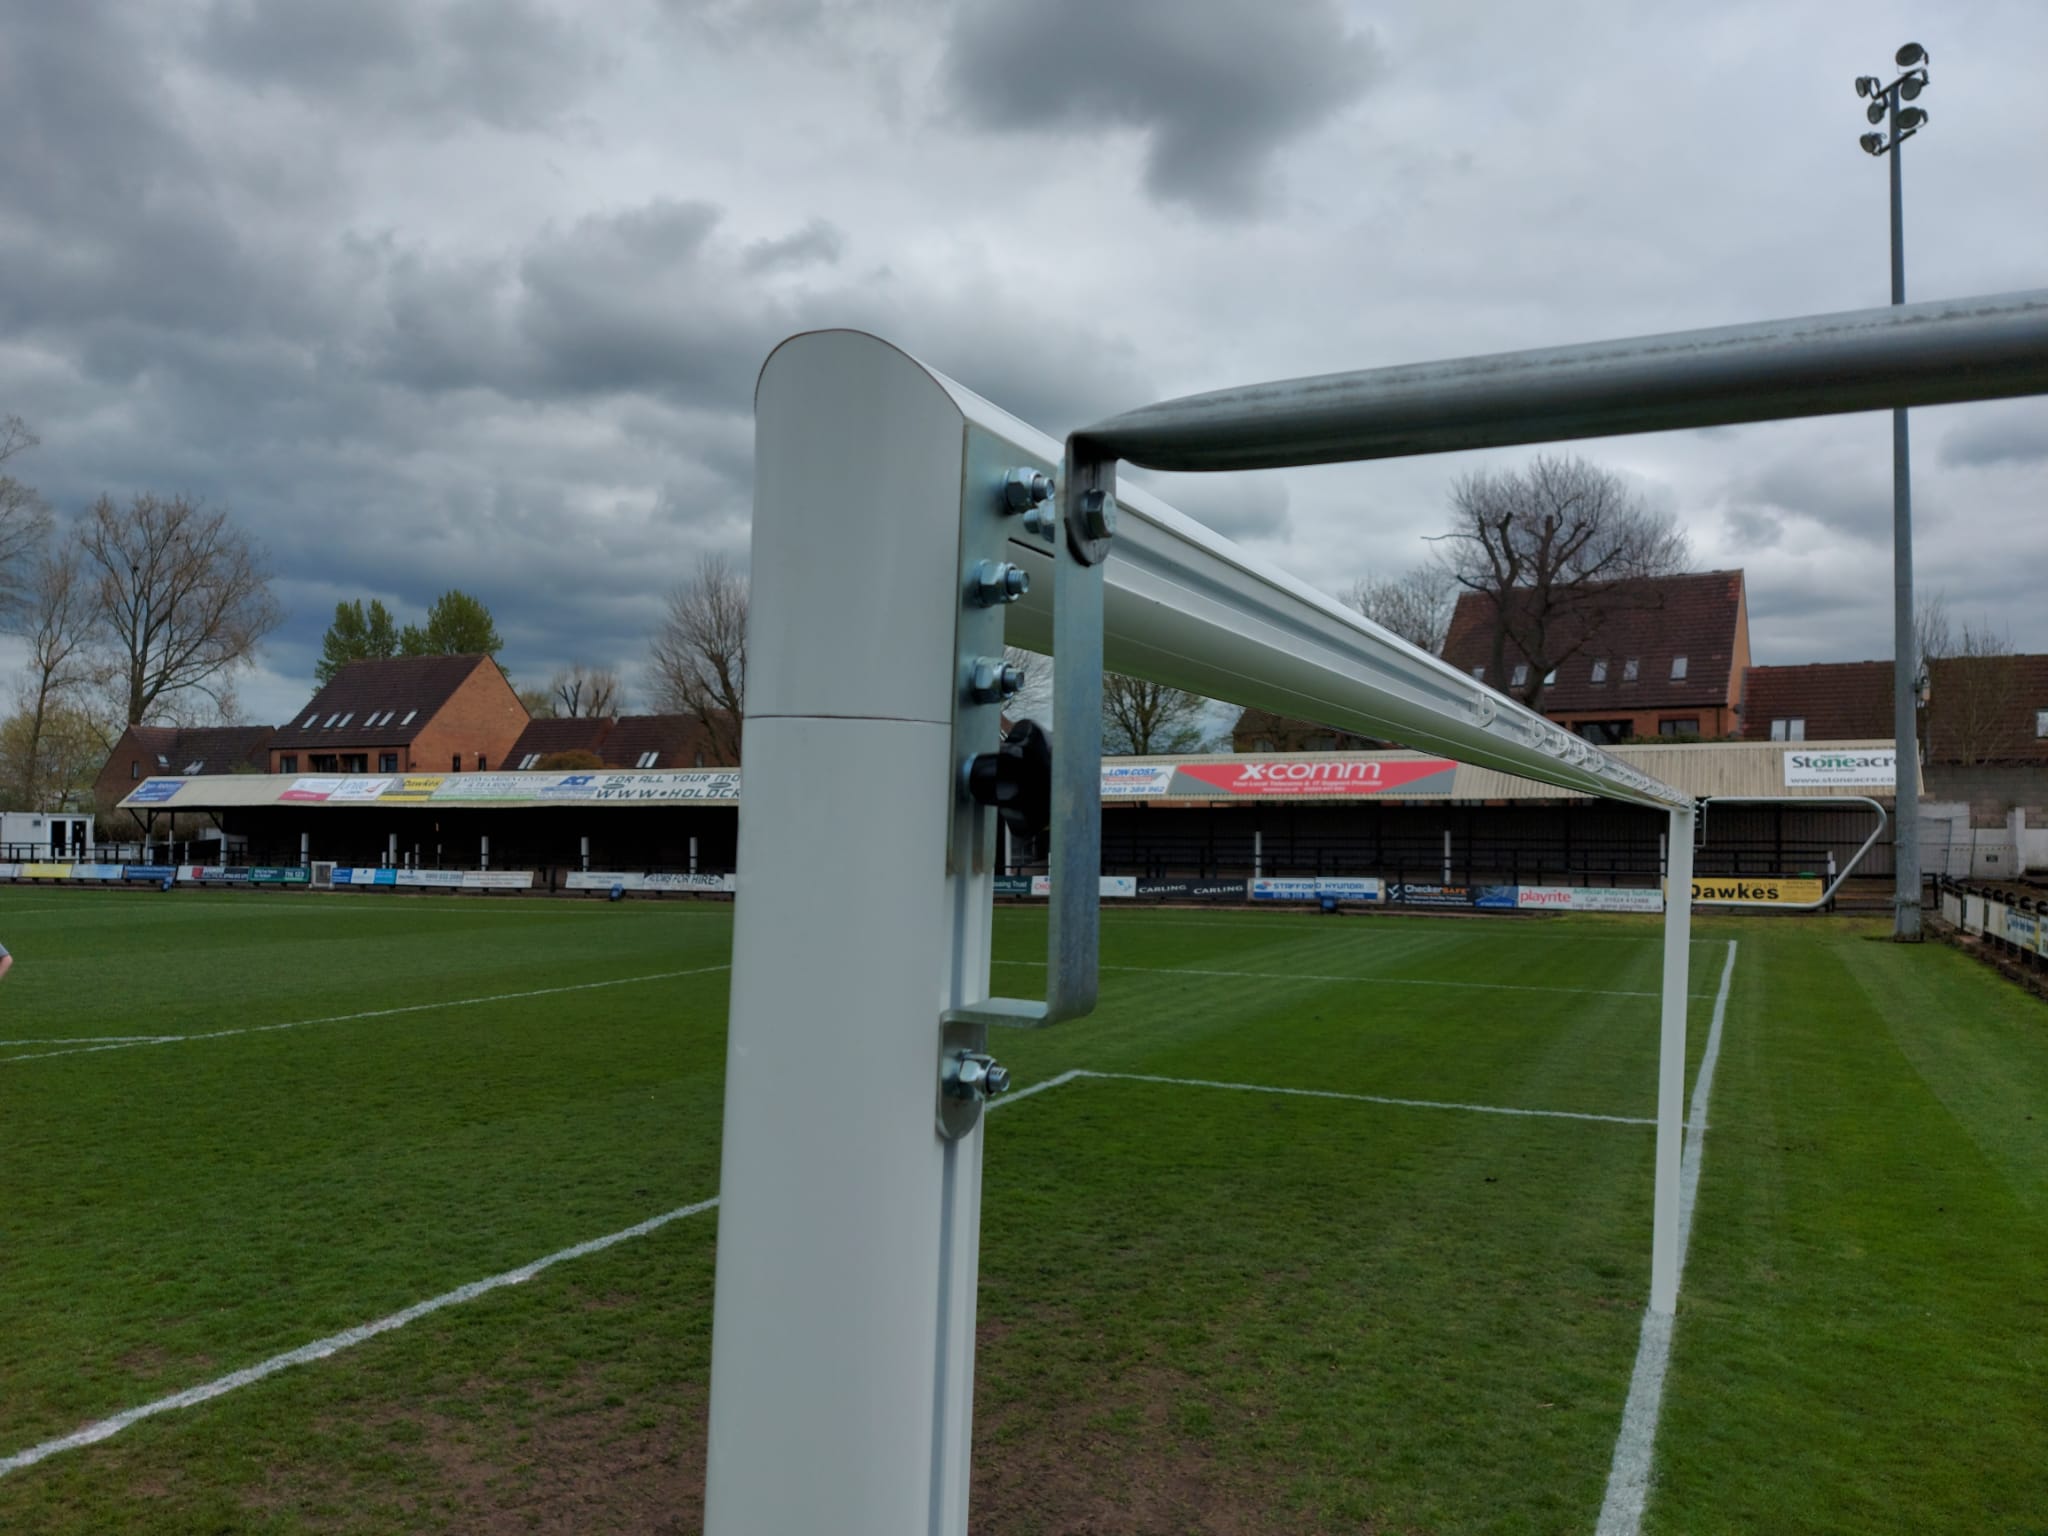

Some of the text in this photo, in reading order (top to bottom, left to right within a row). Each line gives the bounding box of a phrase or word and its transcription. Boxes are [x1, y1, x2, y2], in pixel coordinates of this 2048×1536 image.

[1791, 755, 1896, 769] Stoneacr
[1131, 768, 1157, 776] COST
[671, 775, 710, 783] YOUR
[1138, 885, 1187, 894] CARLING
[1193, 885, 1244, 895] CARLING
[1325, 882, 1365, 890] HYUNDAI
[1520, 890, 1571, 904] playrite
